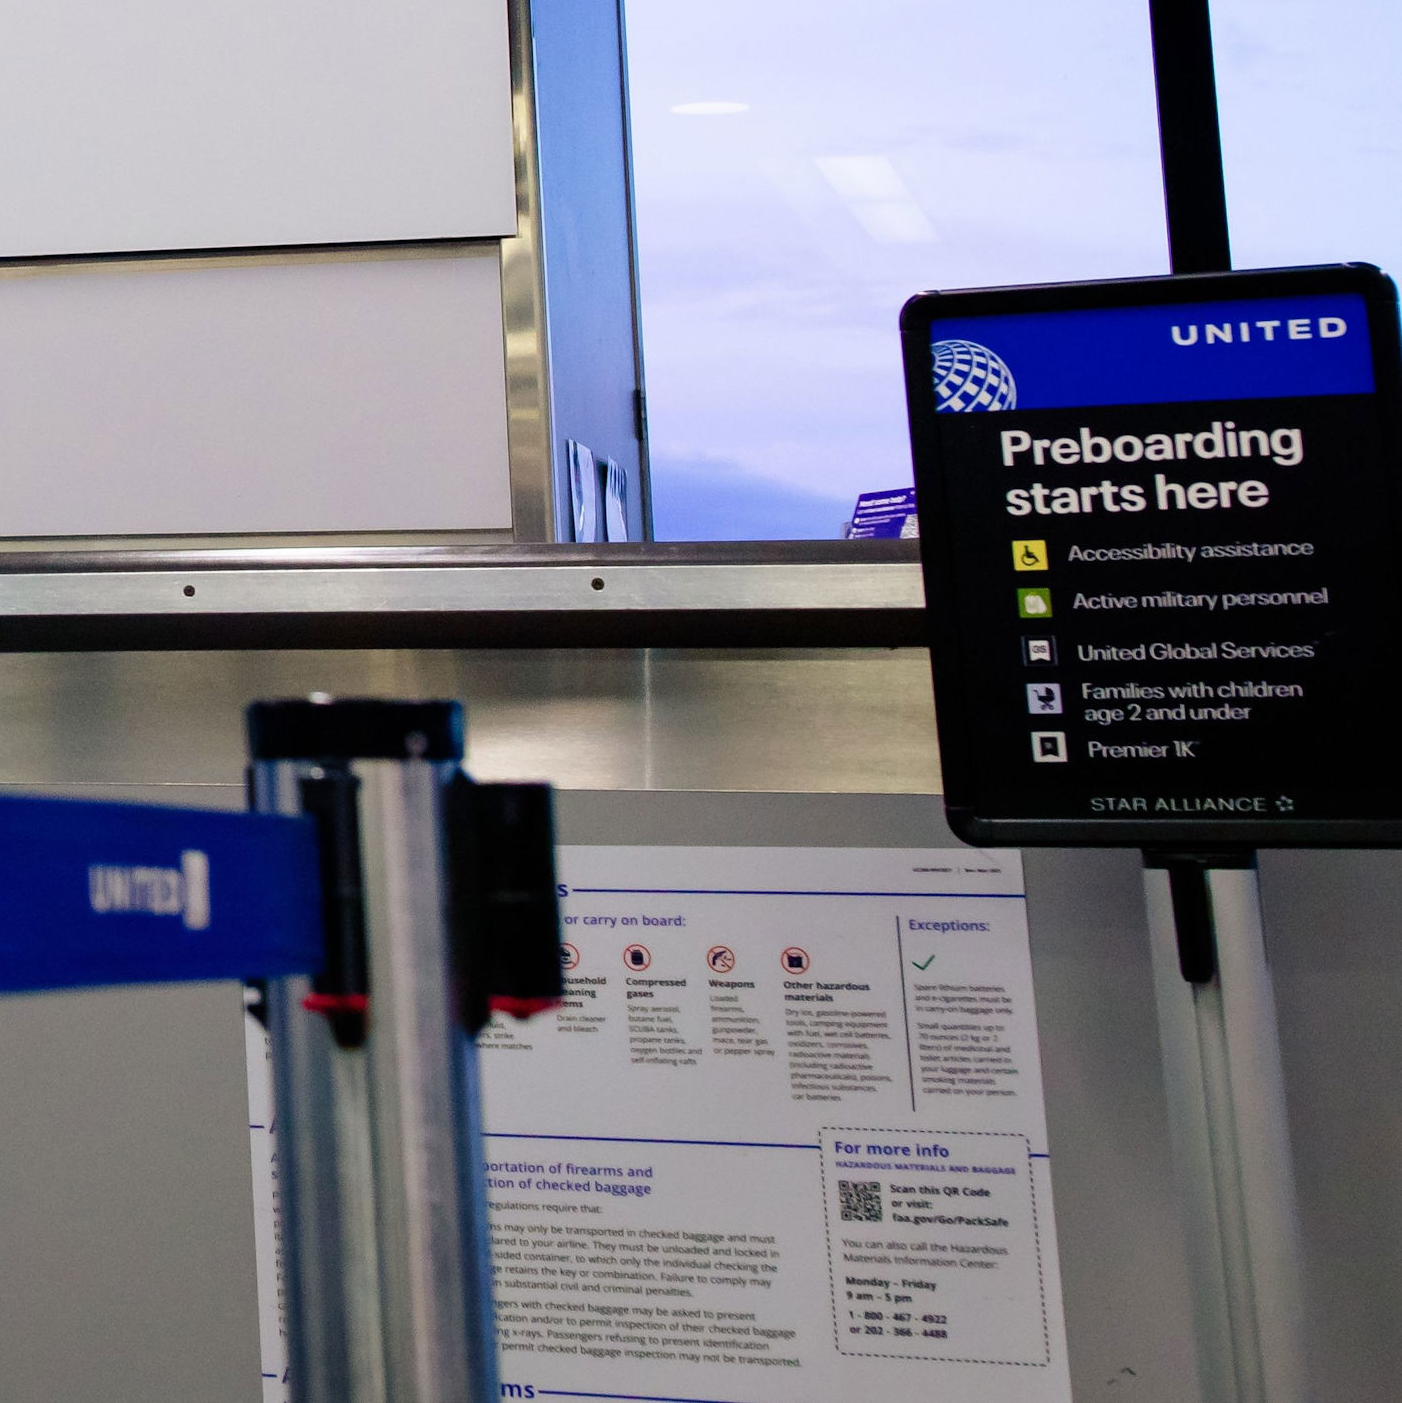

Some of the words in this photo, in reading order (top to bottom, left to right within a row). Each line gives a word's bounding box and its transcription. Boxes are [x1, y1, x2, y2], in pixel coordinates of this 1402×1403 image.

[1171, 317, 1346, 345] UNITED
[1001, 422, 1303, 465] Preboarding
[1006, 481, 1145, 514] starts
[1155, 474, 1268, 509] here
[1068, 543, 1196, 561] Accessibility
[1201, 542, 1313, 557] assistance
[1073, 593, 1137, 609] Active
[1141, 591, 1217, 609] military
[1221, 588, 1328, 609] personnel
[1077, 644, 1146, 661] United
[1149, 643, 1217, 659] Global
[1221, 642, 1314, 658] Services
[1081, 683, 1164, 699] Families
[1168, 682, 1213, 698] with
[1217, 681, 1303, 697] children
[1085, 709, 1123, 724] age
[1127, 703, 1141, 720] 2
[1145, 704, 1185, 720] and
[1189, 703, 1249, 720] under
[1087, 741, 1167, 757] Premier
[1091, 797, 1147, 811] STAR
[1155, 797, 1266, 811] ALLIANCE
[88, 863, 183, 914] UNITED
[564, 915, 578, 925] or
[583, 916, 617, 928] carry
[621, 917, 638, 925] on
[642, 915, 685, 926] board:
[908, 919, 990, 933] Exceptions:
[625, 978, 686, 987] Compressed
[708, 980, 755, 989] Weapons
[783, 981, 812, 989] Other
[815, 982, 870, 990] hazardous
[626, 991, 653, 999] gases
[835, 1141, 860, 1154] For
[866, 1145, 910, 1156] more
[916, 1144, 949, 1157] info
[548, 1162, 561, 1174] of
[565, 1163, 623, 1176] firearms
[627, 1167, 653, 1178] and
[835, 1161, 891, 1169] HAZARDOUS
[894, 1163, 946, 1172] MATERIALS
[971, 1166, 1015, 1174] BAGGAGE
[518, 1178, 531, 1189] of
[535, 1179, 590, 1191] checked
[594, 1181, 651, 1197] baggage
[889, 1184, 916, 1193] Scan
[918, 1186, 940, 1194] this
[942, 1186, 959, 1197] QR
[961, 1187, 990, 1197] Code
[541, 1204, 577, 1214] require
[579, 1204, 602, 1213] that:
[905, 1200, 932, 1209] visit:
[504, 1224, 525, 1234] may
[527, 1224, 548, 1235] only
[550, 1225, 563, 1234] be
[565, 1227, 624, 1237] transported
[626, 1229, 636, 1237] in
[638, 1229, 679, 1239] checked
[681, 1231, 725, 1243] baggage
[727, 1234, 747, 1242] and
[749, 1235, 775, 1244] must
[519, 1238, 529, 1246] to
[531, 1240, 553, 1249] your
[556, 1239, 589, 1249] airline.
[593, 1240, 616, 1253] They
[618, 1244, 643, 1252] must
[646, 1243, 659, 1252] be
[661, 1245, 709, 1255] unloaded
[712, 1247, 731, 1256] and
[734, 1248, 767, 1258] locked
[769, 1250, 779, 1258] in
[841, 1238, 862, 1248] You
[864, 1241, 883, 1249] can
[885, 1241, 907, 1250] also
[909, 1242, 927, 1251] call
[929, 1243, 947, 1252] the
[950, 1244, 1008, 1255] Hazardous
[523, 1253, 572, 1262] container,
[575, 1255, 585, 1263] to
[587, 1255, 617, 1264] which
[619, 1256, 641, 1268] only
[643, 1257, 659, 1267] the
[662, 1259, 711, 1269] individual
[713, 1261, 758, 1274] checking
[760, 1264, 777, 1272] the
[505, 1266, 538, 1275] retains
[541, 1266, 557, 1276] the
[559, 1267, 577, 1279] key
[592, 1270, 657, 1280] combination.
[660, 1272, 694, 1283] Failure
[696, 1275, 707, 1283] to
[709, 1276, 747, 1287] comply
[749, 1278, 771, 1288] may
[845, 1276, 889, 1288] Monday
[901, 1279, 936, 1291] Friday
[846, 1291, 853, 1299] 9
[885, 1293, 891, 1301] 5
[894, 1295, 912, 1304] pm
[521, 1301, 542, 1309] with
[544, 1302, 585, 1311] checked
[587, 1304, 629, 1316] baggage
[631, 1307, 653, 1318] may
[655, 1307, 668, 1316] be
[671, 1309, 701, 1318] asked
[703, 1310, 714, 1319] to
[716, 1312, 755, 1320] present
[530, 1316, 563, 1324] and/or
[566, 1317, 577, 1326] to
[579, 1319, 611, 1327] permit
[614, 1320, 666, 1330] inspection
[669, 1322, 679, 1331] of
[681, 1323, 704, 1332] their
[708, 1324, 750, 1335] checked
[752, 1327, 795, 1339] baggage
[512, 1330, 543, 1340] x-rays.
[546, 1329, 603, 1342] Passengers
[605, 1333, 646, 1346] refusing
[648, 1336, 659, 1345] to
[661, 1338, 700, 1346] present
[702, 1339, 769, 1350] identification
[501, 1342, 534, 1351] permit
[537, 1344, 577, 1354] checked
[579, 1346, 621, 1358] baggage
[624, 1350, 676, 1359] inspection
[678, 1353, 700, 1363] may
[702, 1354, 719, 1362] not
[722, 1354, 735, 1363] be
[738, 1356, 802, 1367] transported.
